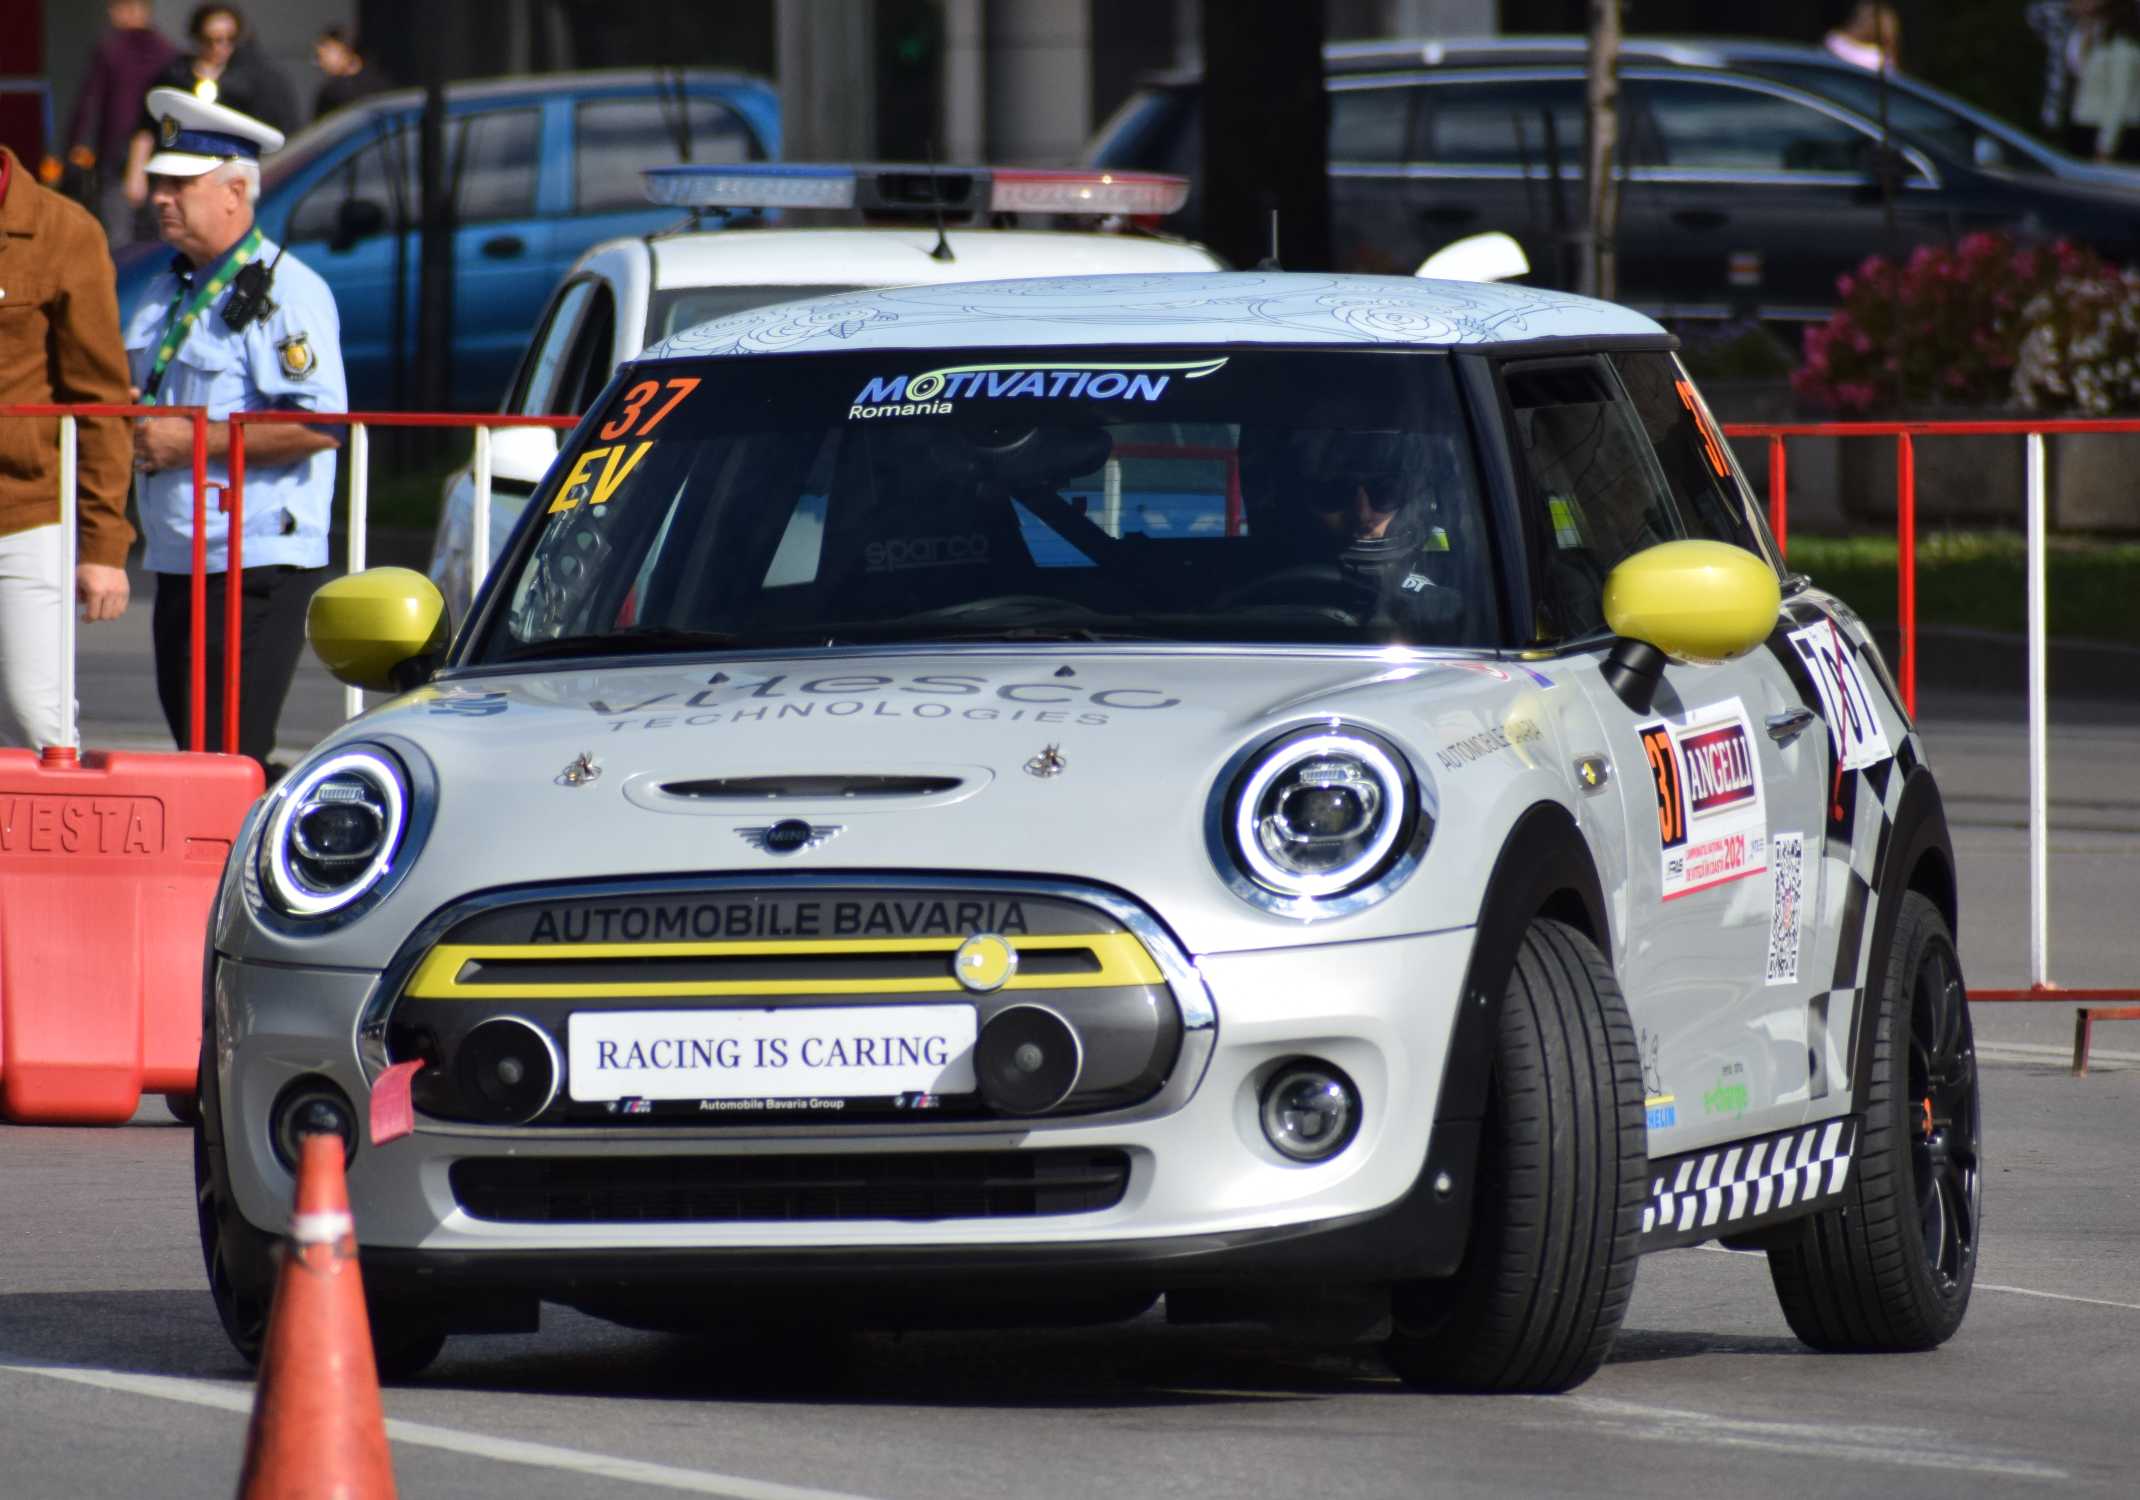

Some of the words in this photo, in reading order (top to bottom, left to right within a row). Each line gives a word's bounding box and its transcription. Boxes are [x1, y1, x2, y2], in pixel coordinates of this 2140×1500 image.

[854, 371, 1170, 404] MOTIVATION
[600, 377, 702, 441] 37
[848, 400, 953, 420] Romania
[547, 440, 655, 514] EV
[864, 532, 990, 573] sparco
[607, 699, 1111, 732] TECHNOLOGIES
[1644, 732, 1682, 843] 37
[1688, 736, 1753, 801] ANGELLI
[1724, 835, 1745, 870] 2021
[529, 902, 821, 944] AUTOMOBILE
[833, 900, 1029, 936] BAVARIA
[596, 1038, 742, 1070] RACING
[753, 1038, 789, 1069] IS
[801, 1036, 949, 1068] CARING
[700, 1099, 764, 1111] Automobile
[766, 1098, 808, 1110] Bavaria
[810, 1097, 845, 1111] Group
